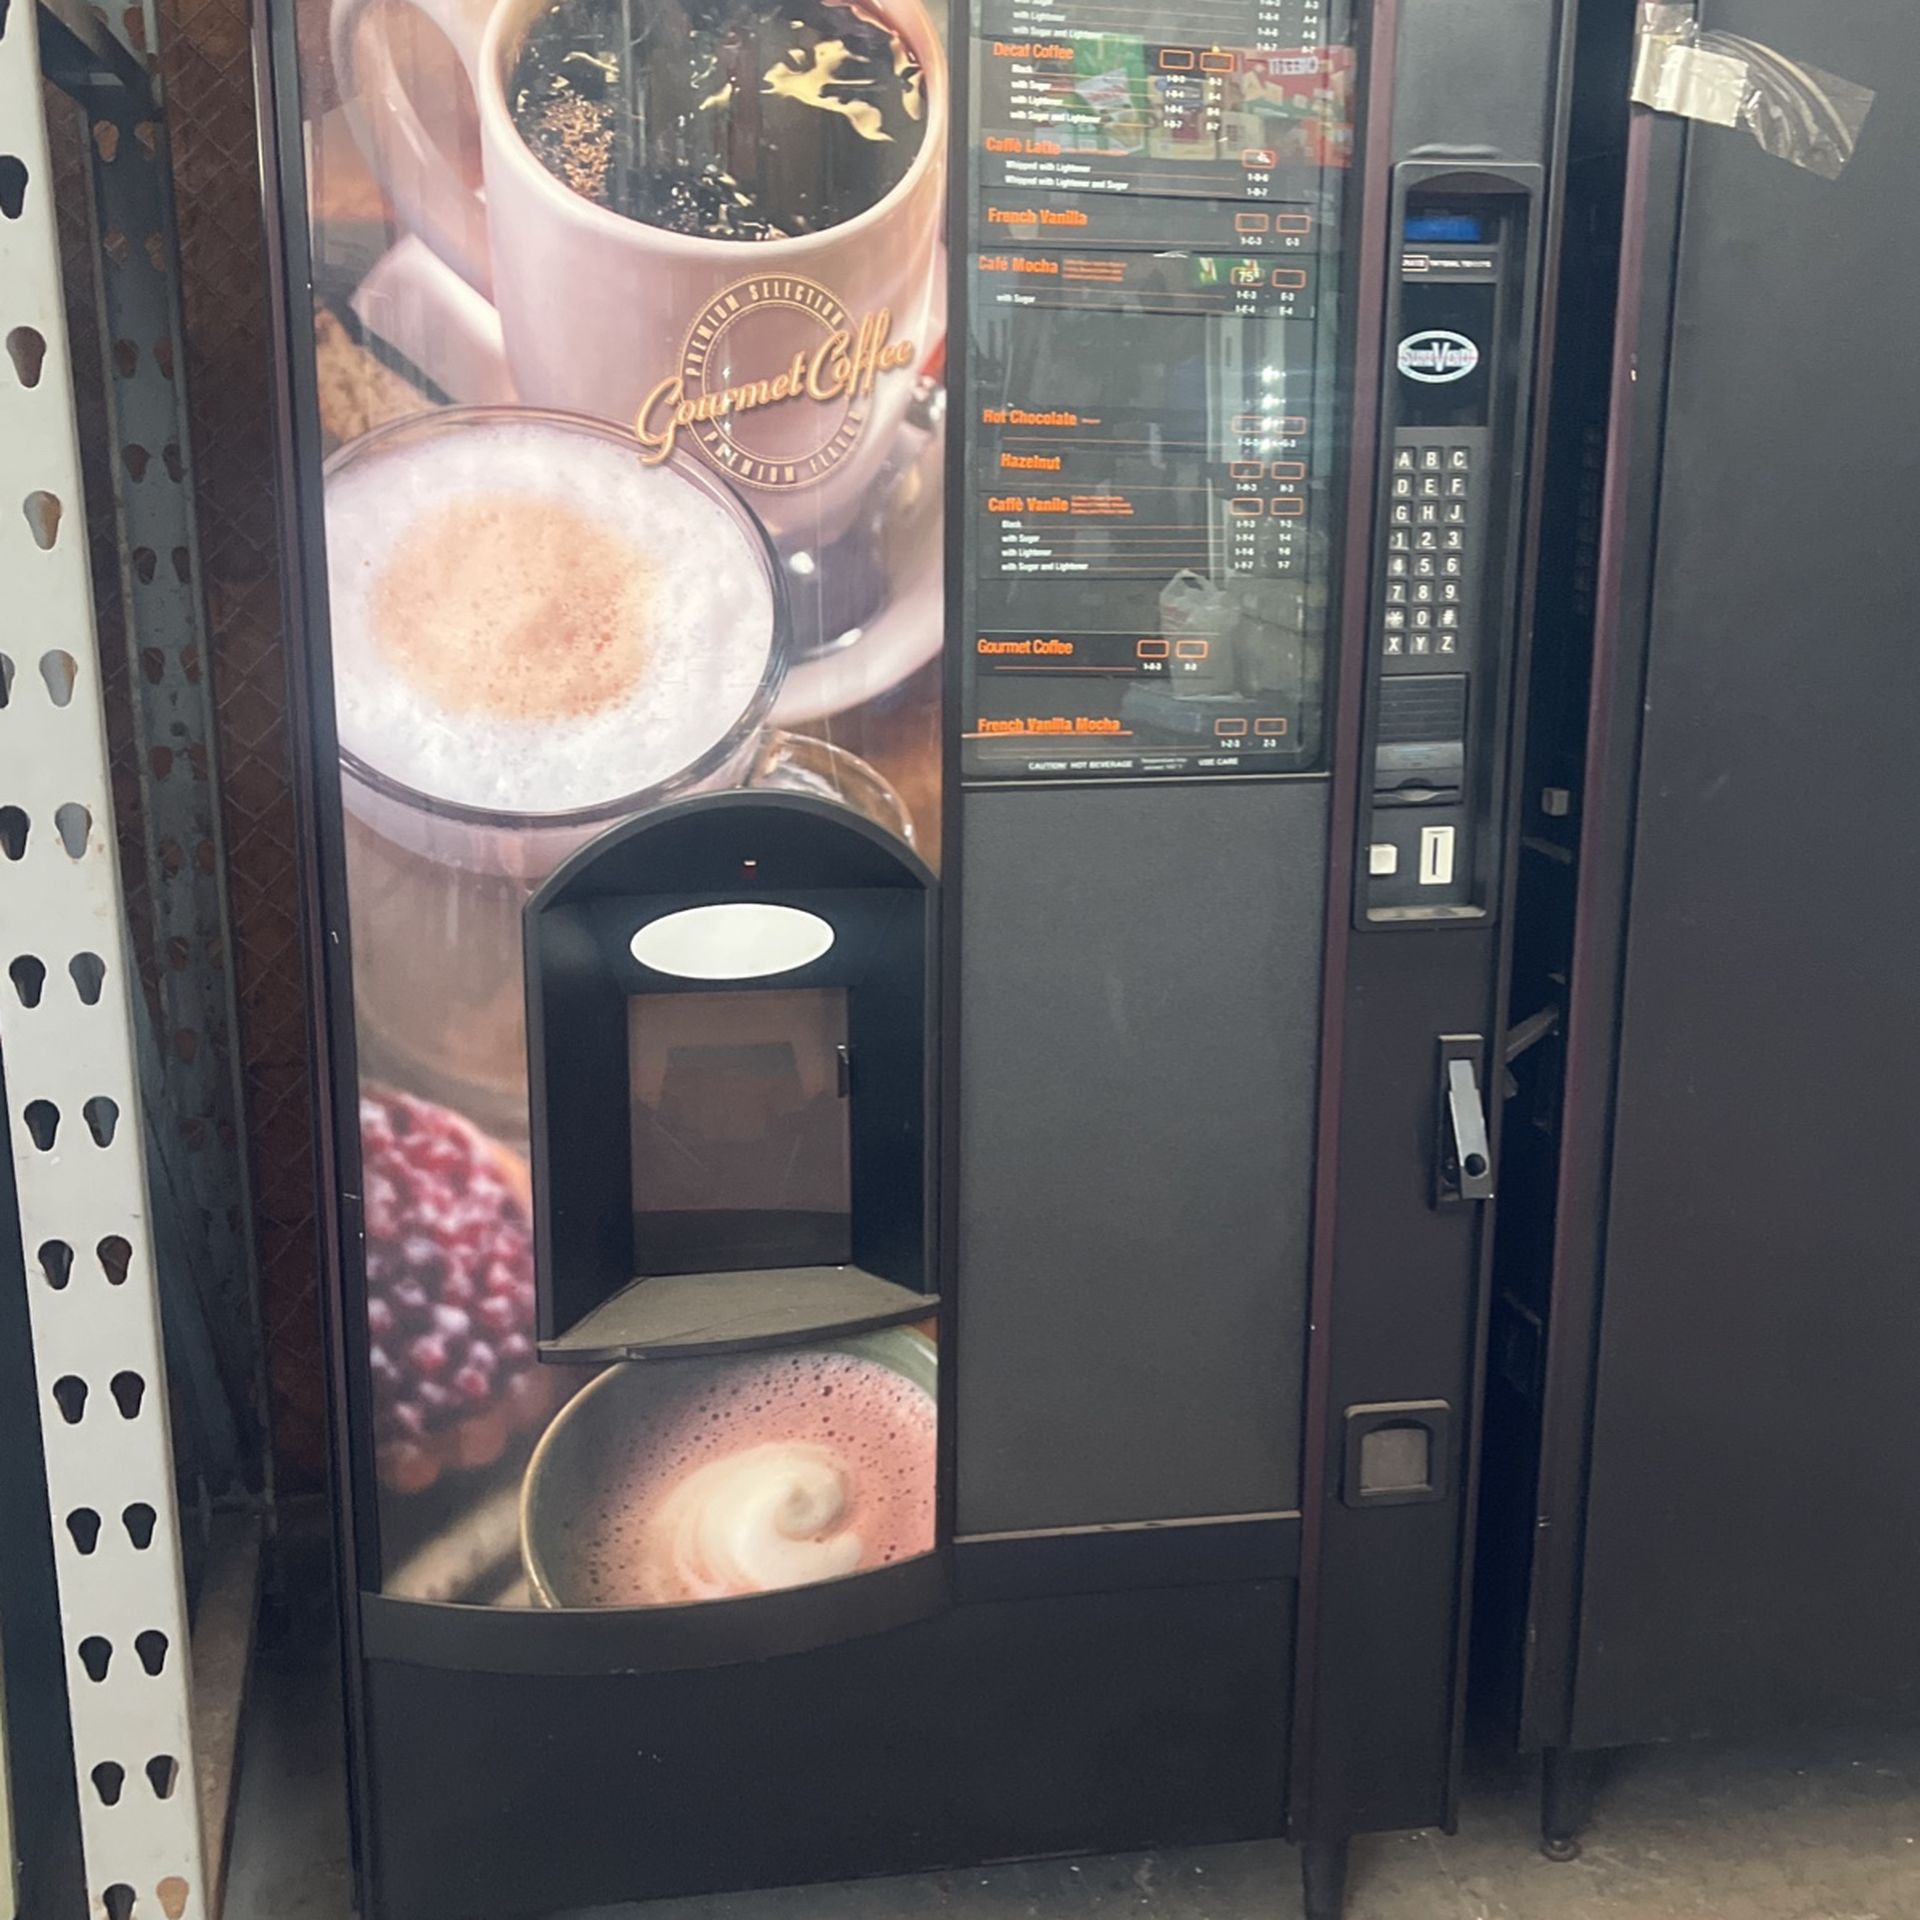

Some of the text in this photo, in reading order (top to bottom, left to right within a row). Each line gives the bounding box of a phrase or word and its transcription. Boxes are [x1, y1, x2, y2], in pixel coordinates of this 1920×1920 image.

[992, 42, 1074, 60] Decaf Coffee
[1029, 81, 1052, 92] Sugar
[1026, 138, 1062, 156] Latte
[1005, 160, 1038, 171] Whipped
[1056, 162, 1091, 174] Lightener
[1004, 175, 1038, 186] Whipped
[1056, 178, 1090, 188] Lightener
[1106, 180, 1128, 192] Sugar
[988, 207, 1088, 226] French Vanilla
[978, 255, 1008, 272] Café
[1012, 257, 1059, 274] Mocha
[1014, 294, 1036, 304] Sugar
[685, 281, 845, 377] PREMIUM SELECTION
[635, 307, 913, 467] Gourmet Coffee
[983, 409, 1078, 426] Hot Chocolate
[704, 431, 795, 483] PREMIUM
[1000, 453, 1062, 470] Hazelnut
[1399, 452, 1464, 467] A B C
[1398, 478, 1462, 494] D E F
[1396, 505, 1460, 520] G H J
[1018, 534, 1040, 544] Sugar
[1396, 532, 1458, 547] 1 2 3
[1018, 548, 1052, 558] Lightener
[1018, 562, 1040, 572] Sugar
[1055, 562, 1089, 573] Lightener
[1393, 558, 1456, 572] 4 5 6
[1392, 584, 1455, 600] 7 8 9
[1417, 610, 1454, 625] 0 #
[978, 638, 1074, 655] Gourmet Coffee
[1389, 636, 1452, 652] X Y Z
[978, 717, 1121, 732] French Vanilla Mocha
[1070, 760, 1088, 769] HOT
[1089, 760, 1133, 768] BEVERAGE
[1198, 758, 1214, 766] USE
[1216, 758, 1238, 766] CARE
